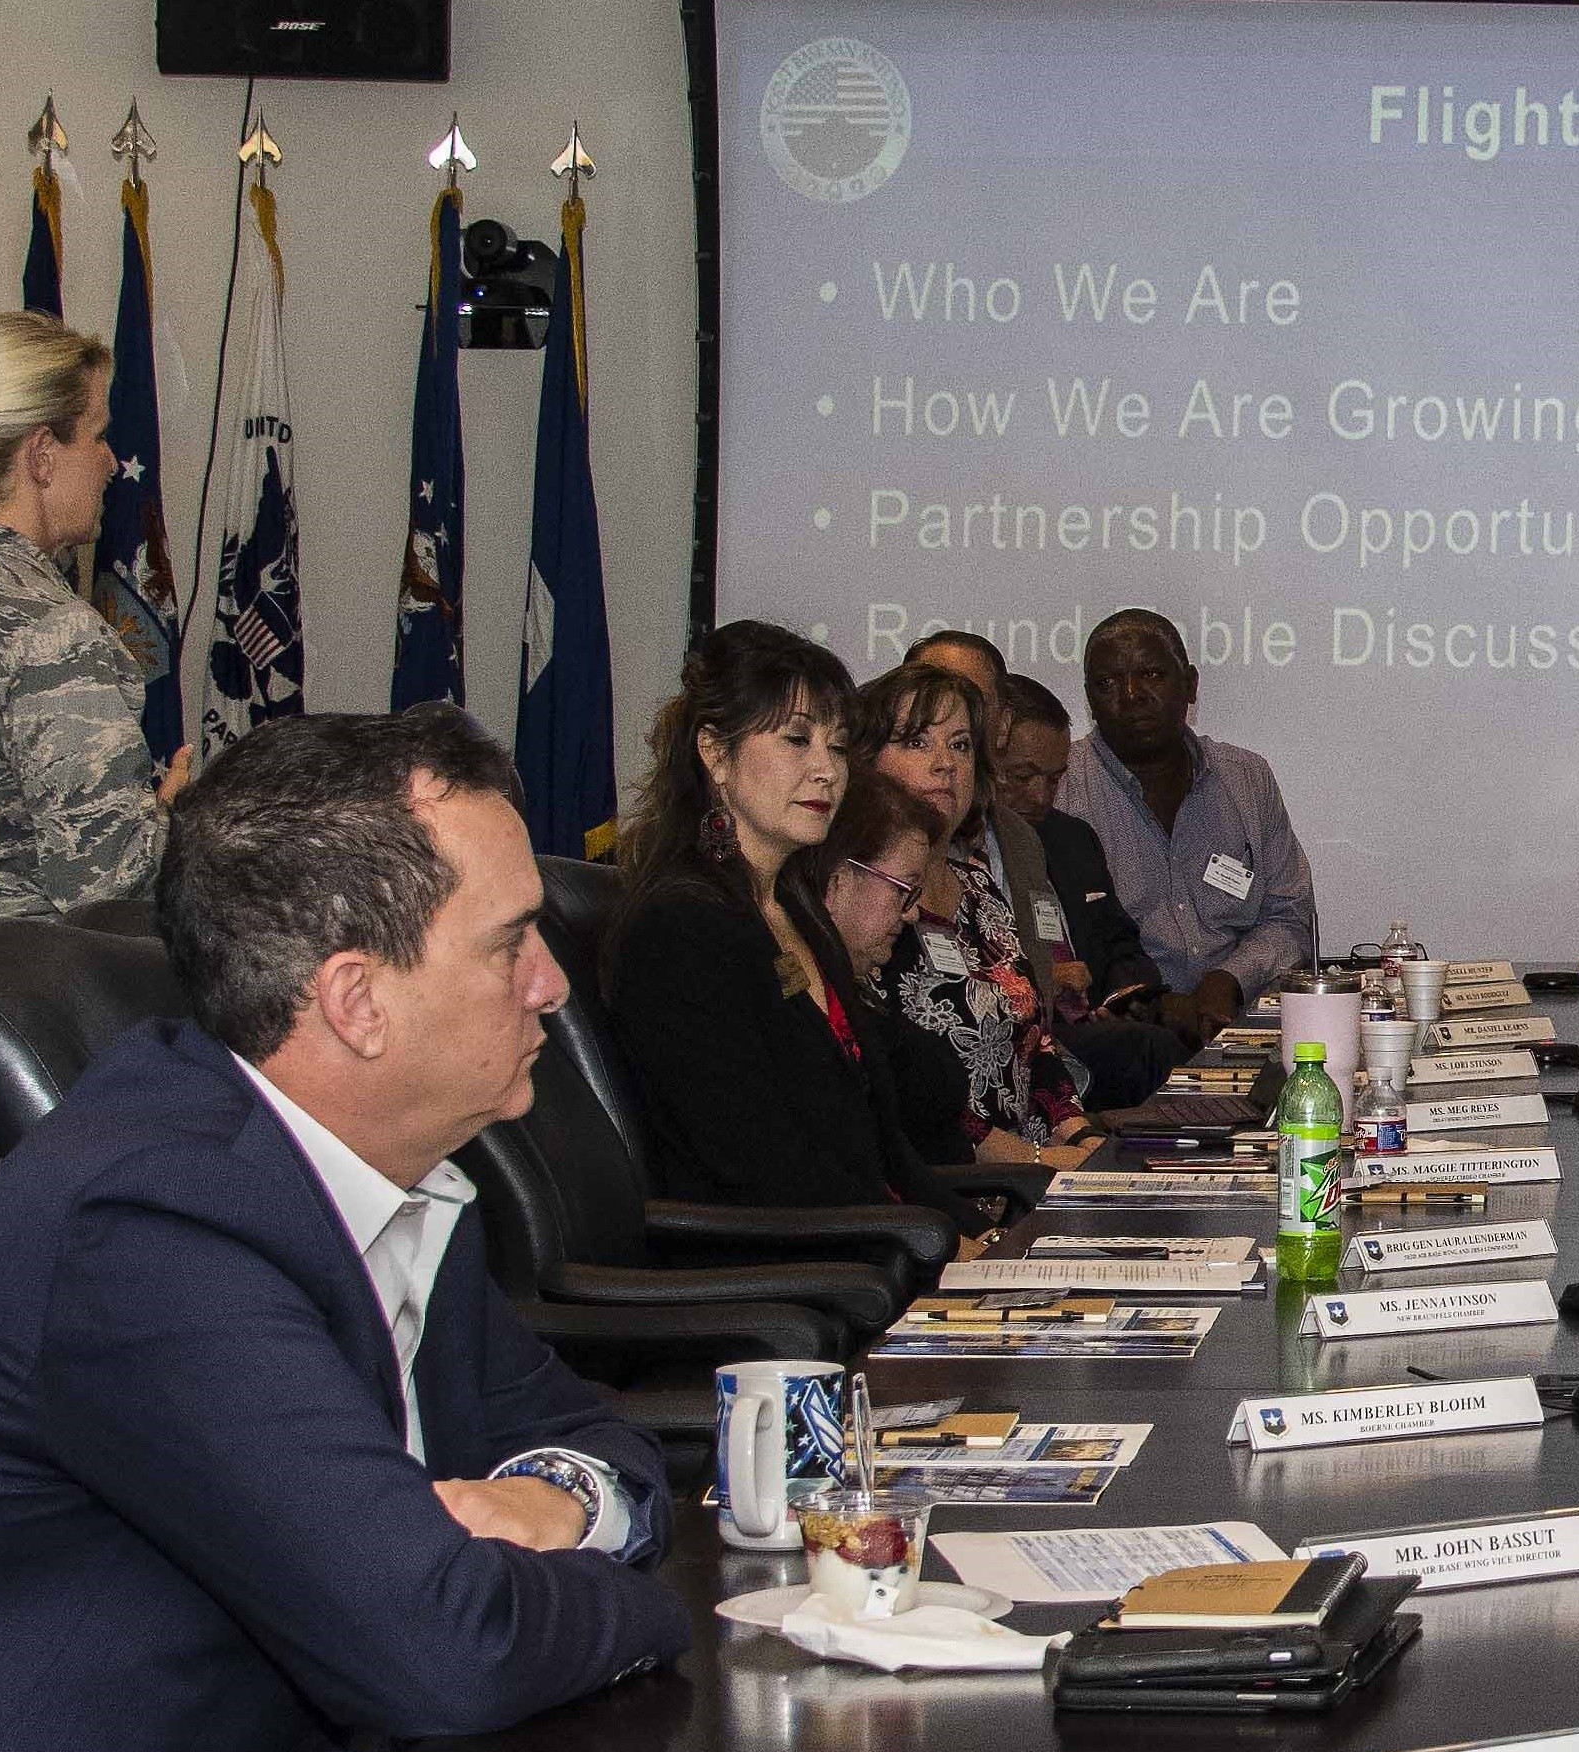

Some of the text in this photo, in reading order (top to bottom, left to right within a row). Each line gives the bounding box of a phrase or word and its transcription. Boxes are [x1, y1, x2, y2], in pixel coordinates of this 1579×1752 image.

[270, 22, 325, 31] BOSE
[872, 261, 1301, 325] Who We Are
[871, 376, 1017, 438] How
[1047, 376, 1150, 439] We
[1178, 378, 1294, 441] Are
[869, 489, 1268, 554] Partnership
[1429, 1103, 1500, 1116] MS. MEG REYES
[1391, 1158, 1540, 1176] MS. MAGGIE TITTERINGTON
[1386, 1230, 1528, 1254] BRIG GEN LAURA LENDERMAN
[1380, 1293, 1498, 1313] MS. JENNA VINSON
[1300, 1396, 1486, 1425] MS. KIMBERLEY BLOHM
[1360, 1419, 1435, 1433] BOERNE CHAMBER
[1395, 1529, 1556, 1564] MR. JOHN BASSUT
[1421, 1564, 1437, 1575] AIR
[1438, 1562, 1462, 1573] BASE
[1464, 1559, 1490, 1571] WING
[1491, 1557, 1513, 1568] VICE
[1515, 1550, 1562, 1566] DIRECTOR
